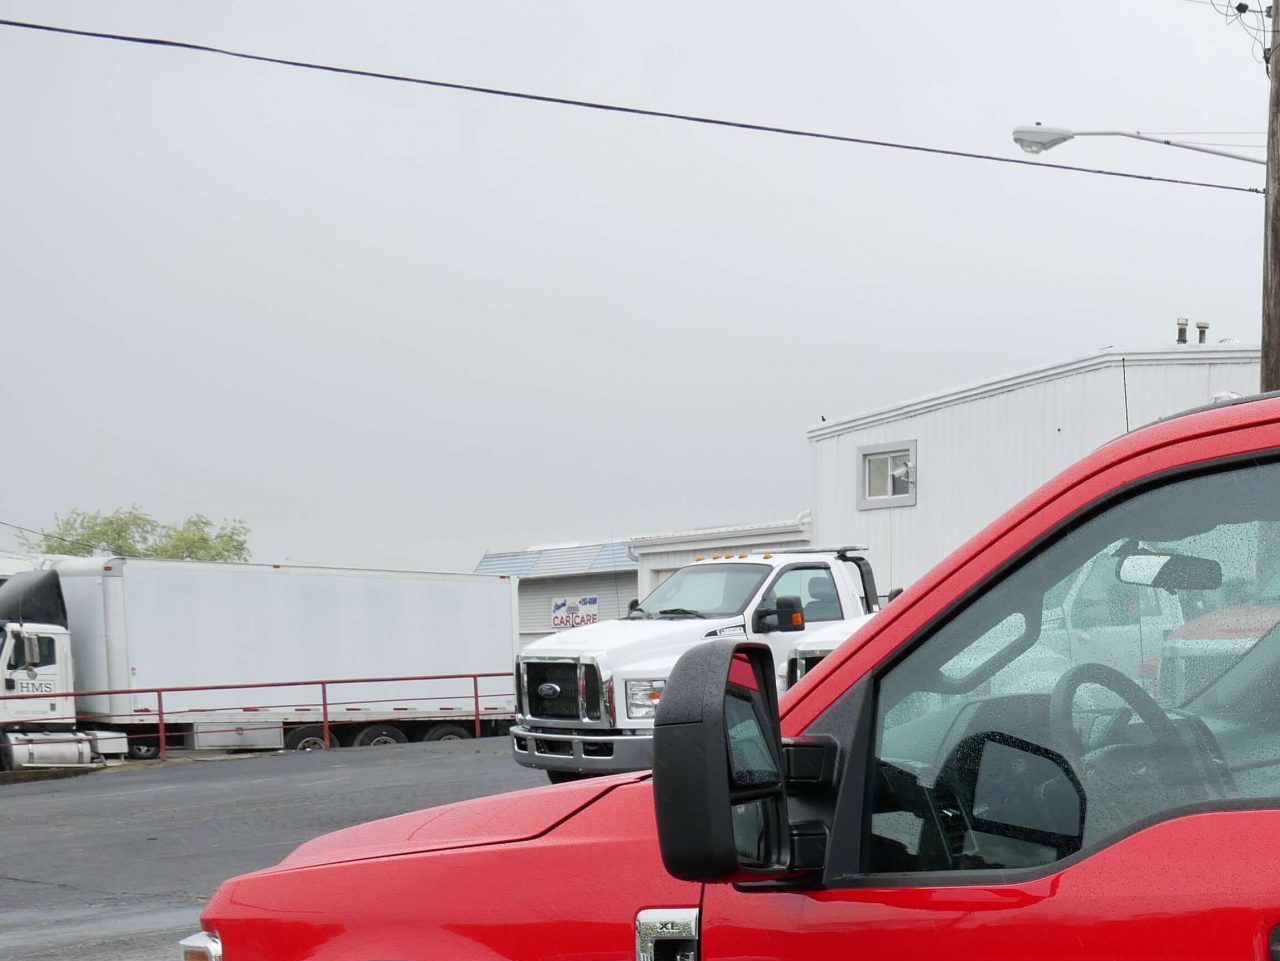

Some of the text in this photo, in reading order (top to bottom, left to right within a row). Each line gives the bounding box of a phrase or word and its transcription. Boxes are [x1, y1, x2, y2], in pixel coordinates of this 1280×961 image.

[553, 613, 597, 627] CAR CARE
[19, 682, 53, 693] HMS
[658, 922, 679, 931] XL
